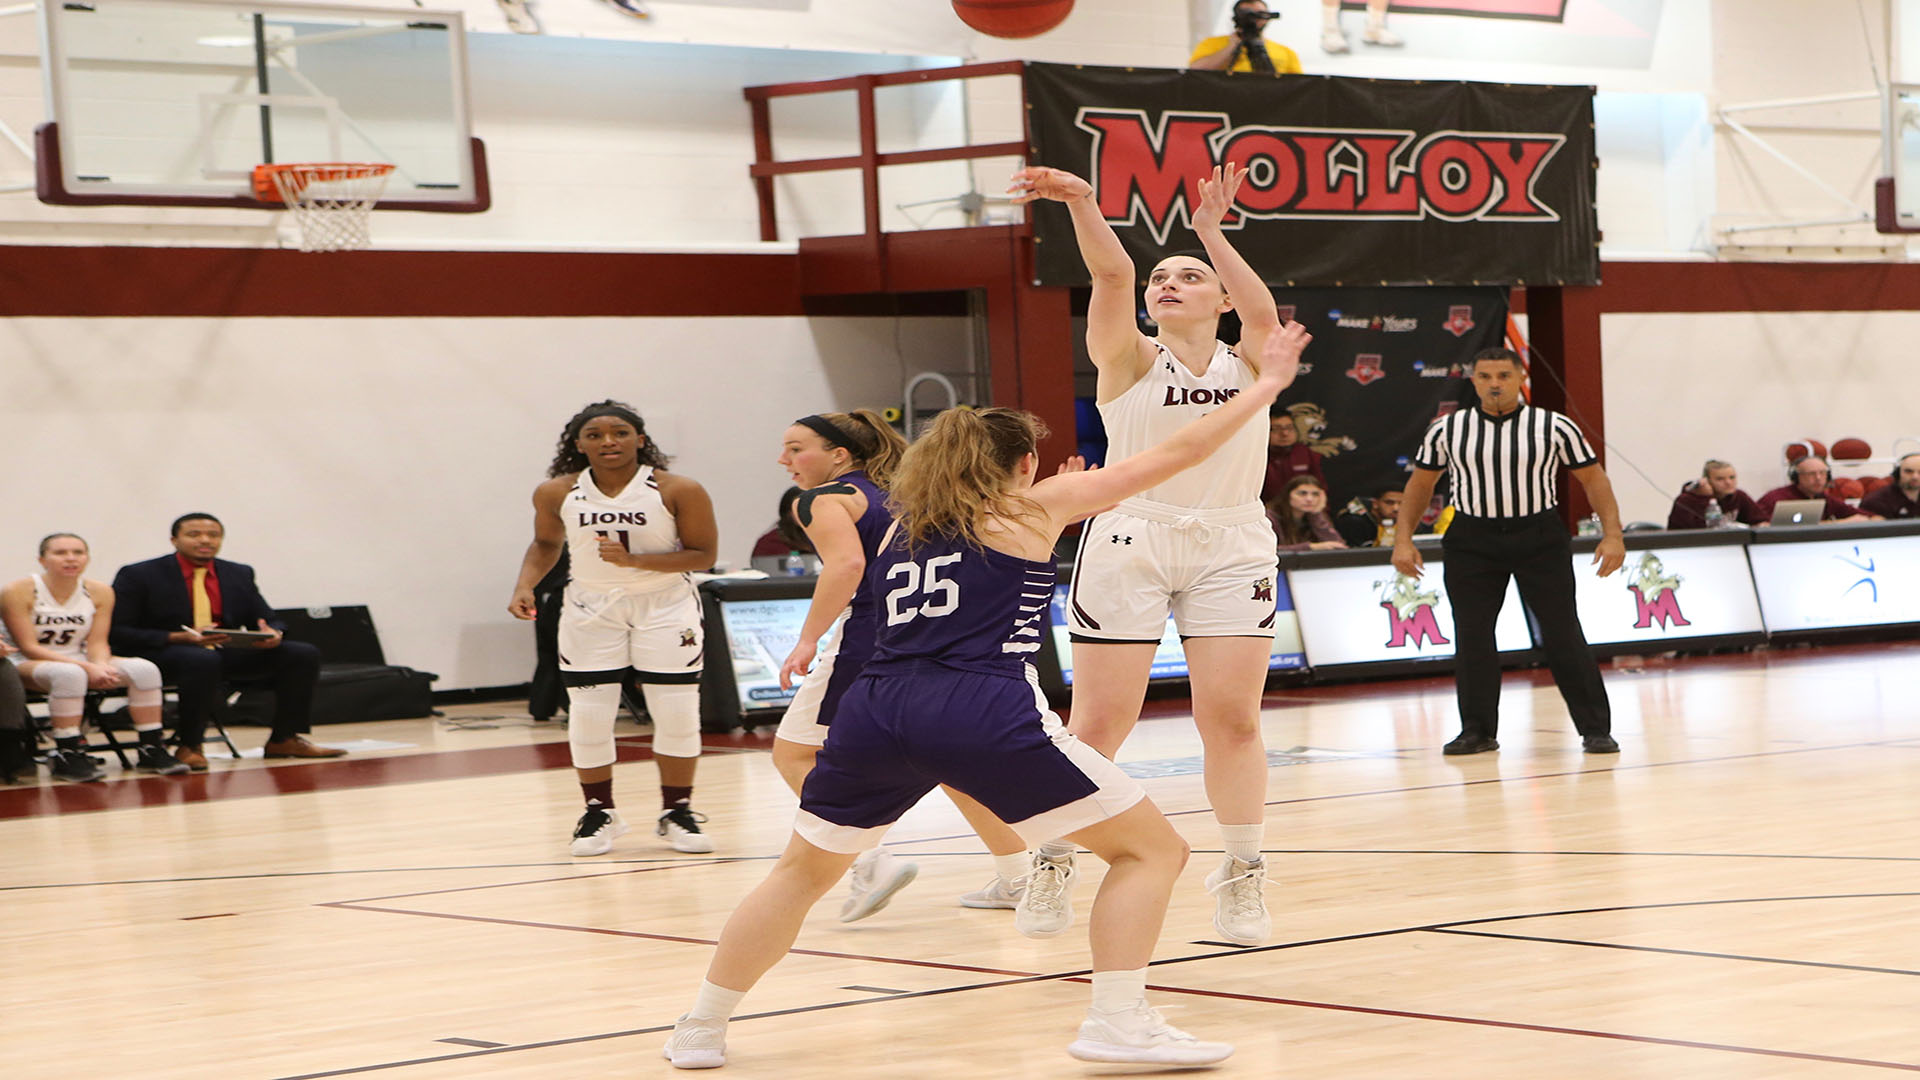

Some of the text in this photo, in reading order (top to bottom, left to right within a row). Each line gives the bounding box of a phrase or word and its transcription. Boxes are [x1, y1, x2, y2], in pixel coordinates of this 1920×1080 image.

[1076, 107, 1566, 245] MOLLOY
[579, 511, 647, 528] LIONS
[885, 552, 962, 627] 25
[35, 614, 86, 625] LIONS
[37, 629, 76, 645] 25
